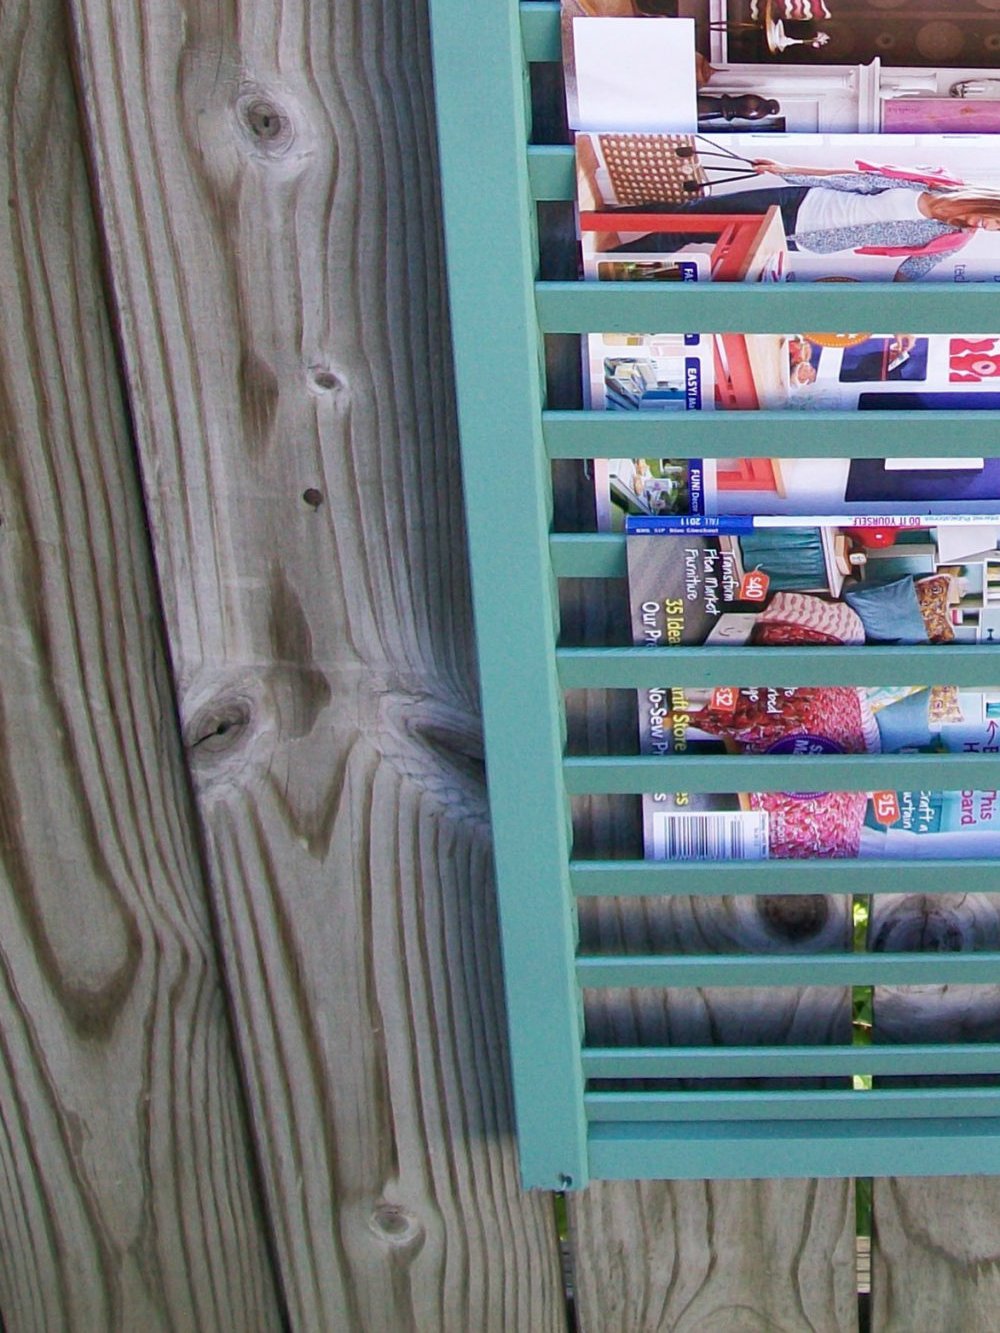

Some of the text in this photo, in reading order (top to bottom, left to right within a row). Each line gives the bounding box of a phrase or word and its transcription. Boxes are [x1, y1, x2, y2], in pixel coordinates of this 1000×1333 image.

[687, 368, 698, 396] EASY!
[690, 469, 701, 491] FUN!
[680, 518, 719, 526] FALL 2011
[851, 517, 921, 526] DO IT YOURSELF
[684, 548, 700, 602] Furniture
[702, 548, 720, 615] Flea Market
[721, 549, 739, 602] Transform
[745, 577, 763, 598] $40
[641, 601, 661, 627] Our
[666, 598, 684, 615] 35
[666, 617, 685, 647] Idea
[672, 714, 690, 751] Store
[878, 794, 895, 816] $15
[920, 824, 930, 832] a
